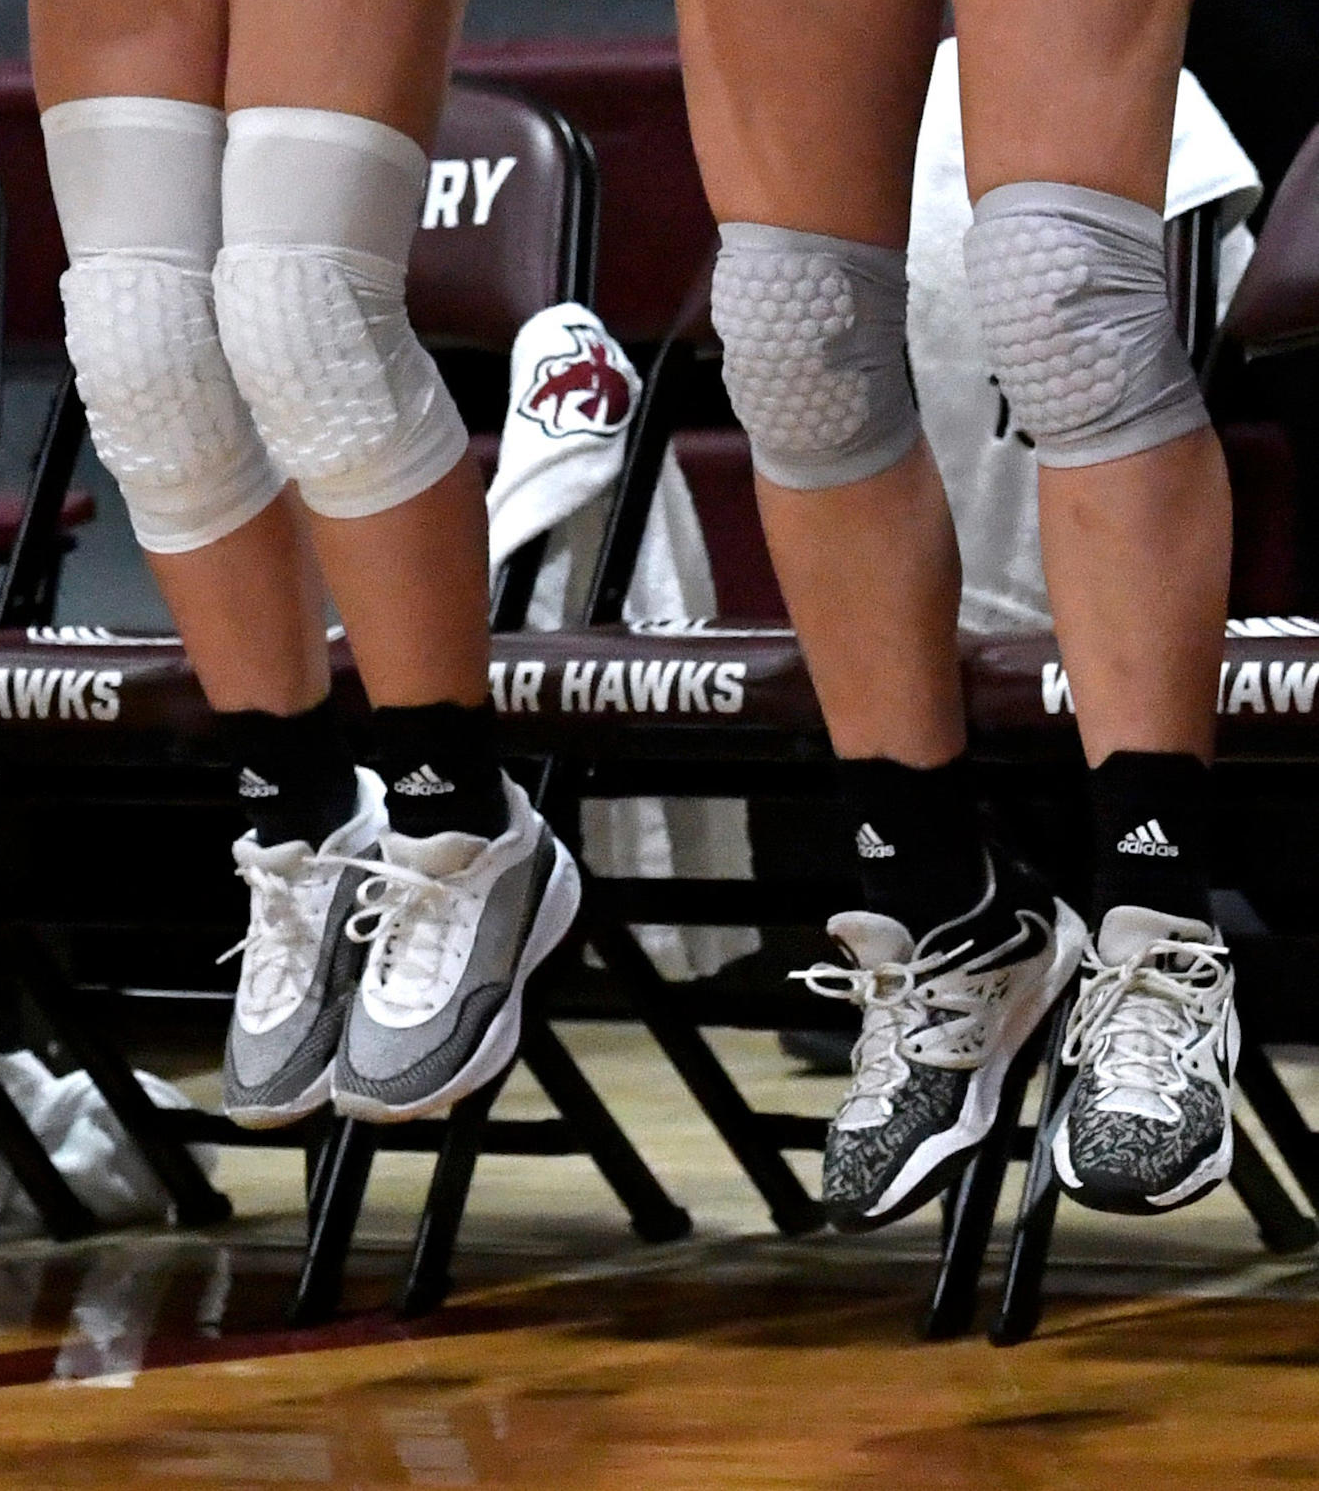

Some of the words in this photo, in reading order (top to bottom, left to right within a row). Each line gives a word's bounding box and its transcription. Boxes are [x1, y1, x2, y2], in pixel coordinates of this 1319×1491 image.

[488, 660, 546, 712] AR
[561, 660, 748, 714] HAWKS
[1117, 838, 1179, 857] adidas
